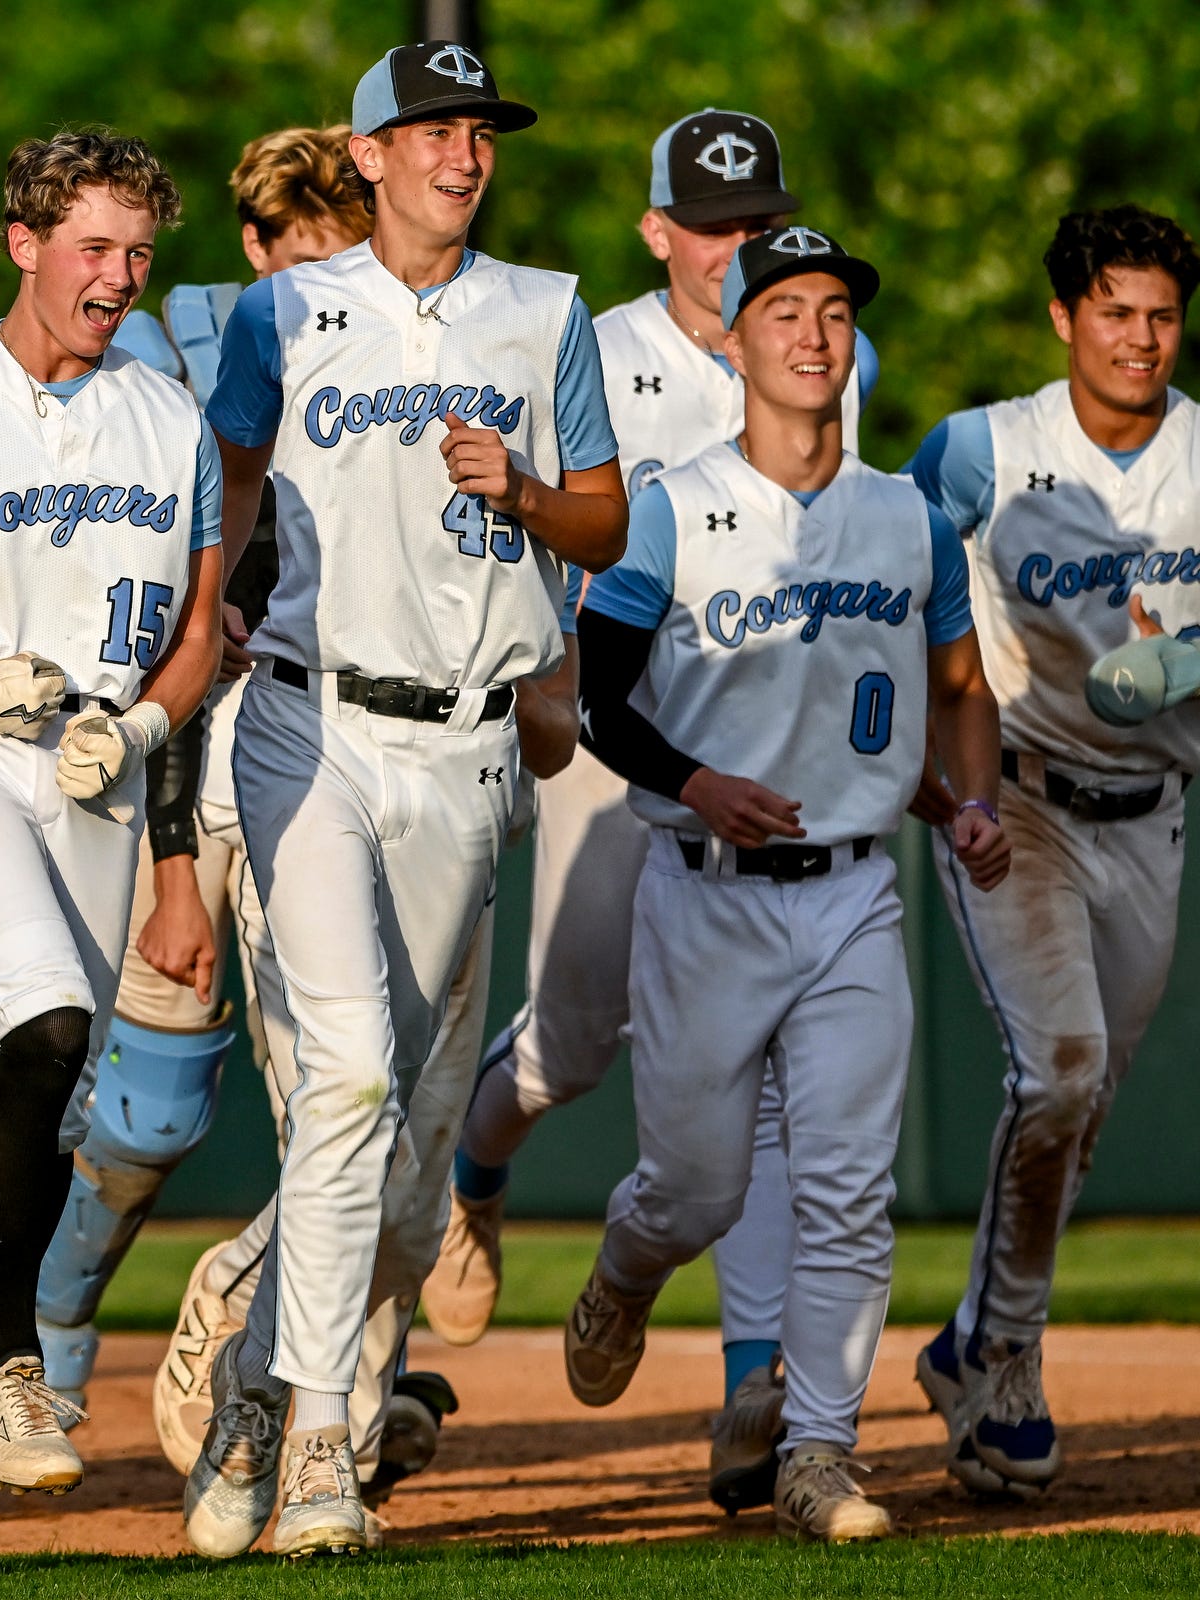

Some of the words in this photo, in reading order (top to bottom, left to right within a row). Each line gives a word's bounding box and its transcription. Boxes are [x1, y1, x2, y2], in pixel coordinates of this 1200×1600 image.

[305, 384, 525, 448] Cougars
[441, 487, 525, 564] 45
[1017, 547, 1200, 608] Cougar
[99, 577, 174, 670] 15
[705, 580, 912, 649] Cougars
[849, 671, 895, 755] 0
